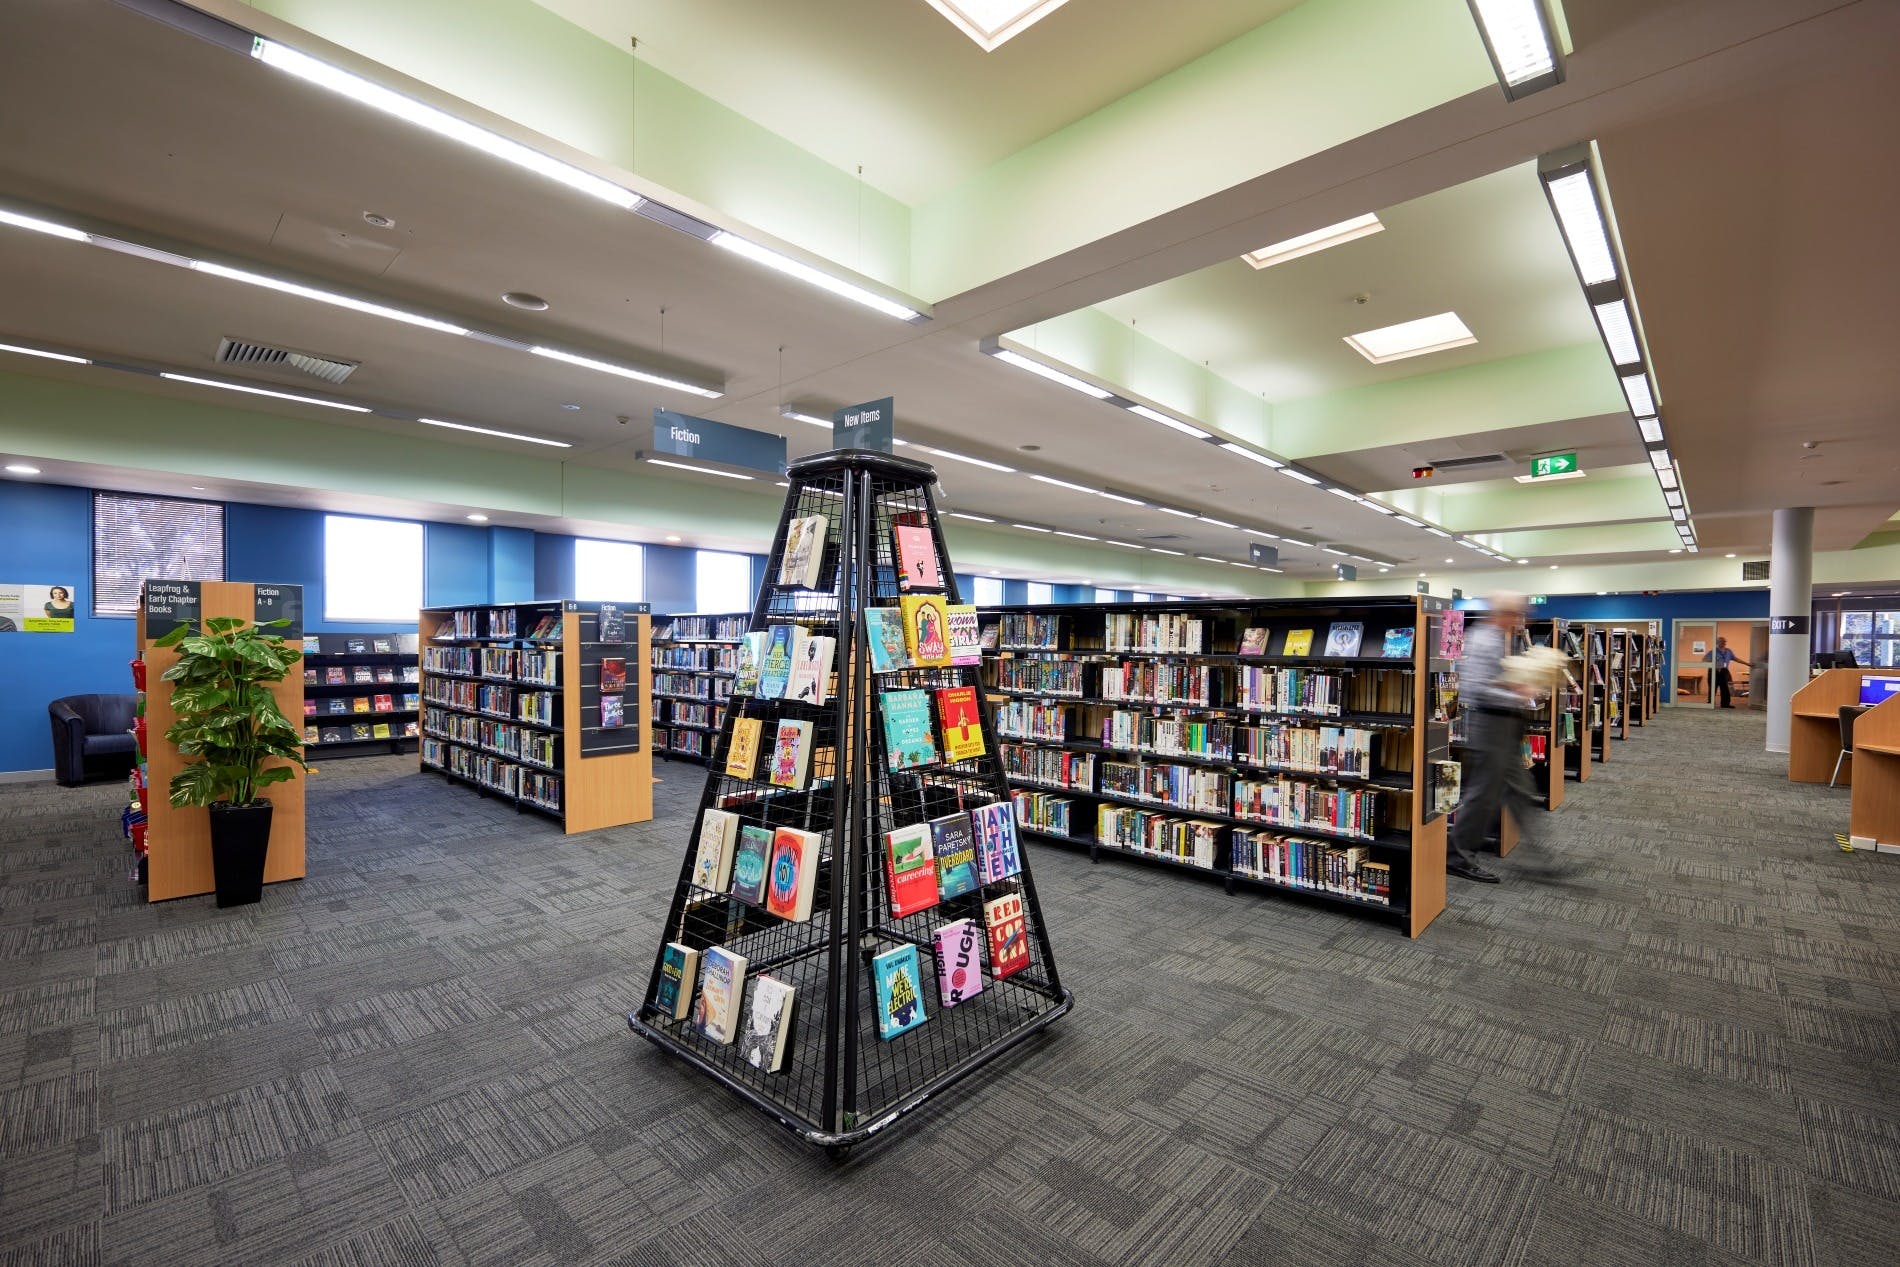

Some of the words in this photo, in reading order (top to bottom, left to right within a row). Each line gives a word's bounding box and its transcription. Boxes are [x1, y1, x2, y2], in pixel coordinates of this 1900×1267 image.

[844, 414, 859, 428] New
[860, 409, 880, 424] Items
[670, 426, 700, 445] Fiction
[148, 583, 181, 594] Leapfrog
[183, 584, 189, 593] &
[257, 587, 280, 596] Fiction
[148, 594, 167, 604] Early
[168, 595, 197, 605] Chapter
[257, 598, 263, 606] A
[267, 598, 273, 606] B
[148, 605, 172, 614] Books
[1771, 620, 1786, 630] EXIT
[919, 641, 944, 654] SWAY
[887, 692, 924, 703] BARBARA
[604, 702, 621, 710] Three
[945, 829, 964, 842] SARA
[938, 835, 971, 852] PARETSKY
[940, 848, 975, 869] OVERBOARD
[896, 864, 935, 884] careering
[993, 898, 1021, 921] RED
[934, 933, 947, 977] ROUGH
[708, 960, 730, 976] DEBORAH
[886, 964, 909, 989] MAYBE
[886, 985, 919, 1015] ELECTRIC
